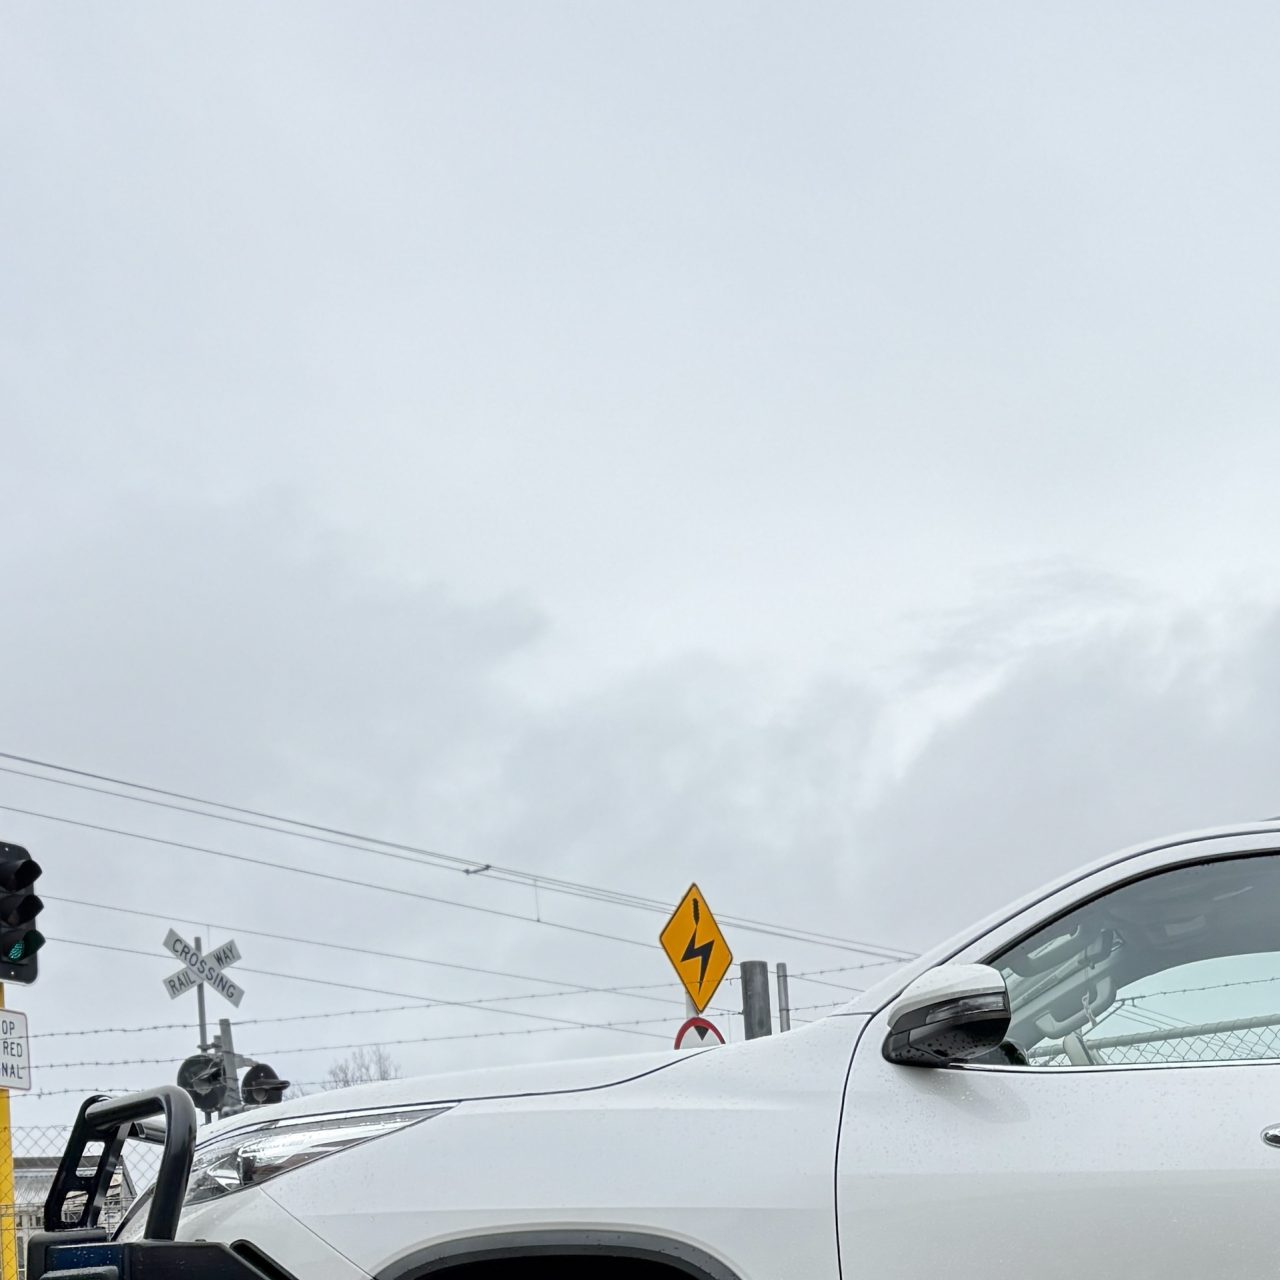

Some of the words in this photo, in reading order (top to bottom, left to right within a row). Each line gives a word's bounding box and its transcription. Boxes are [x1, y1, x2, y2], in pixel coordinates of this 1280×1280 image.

[168, 971, 196, 995] RAIL
[213, 945, 235, 967] WAY
[172, 938, 236, 998] CROSSING
[3, 1041, 23, 1058] RED
[2, 1062, 23, 1079] NAL
